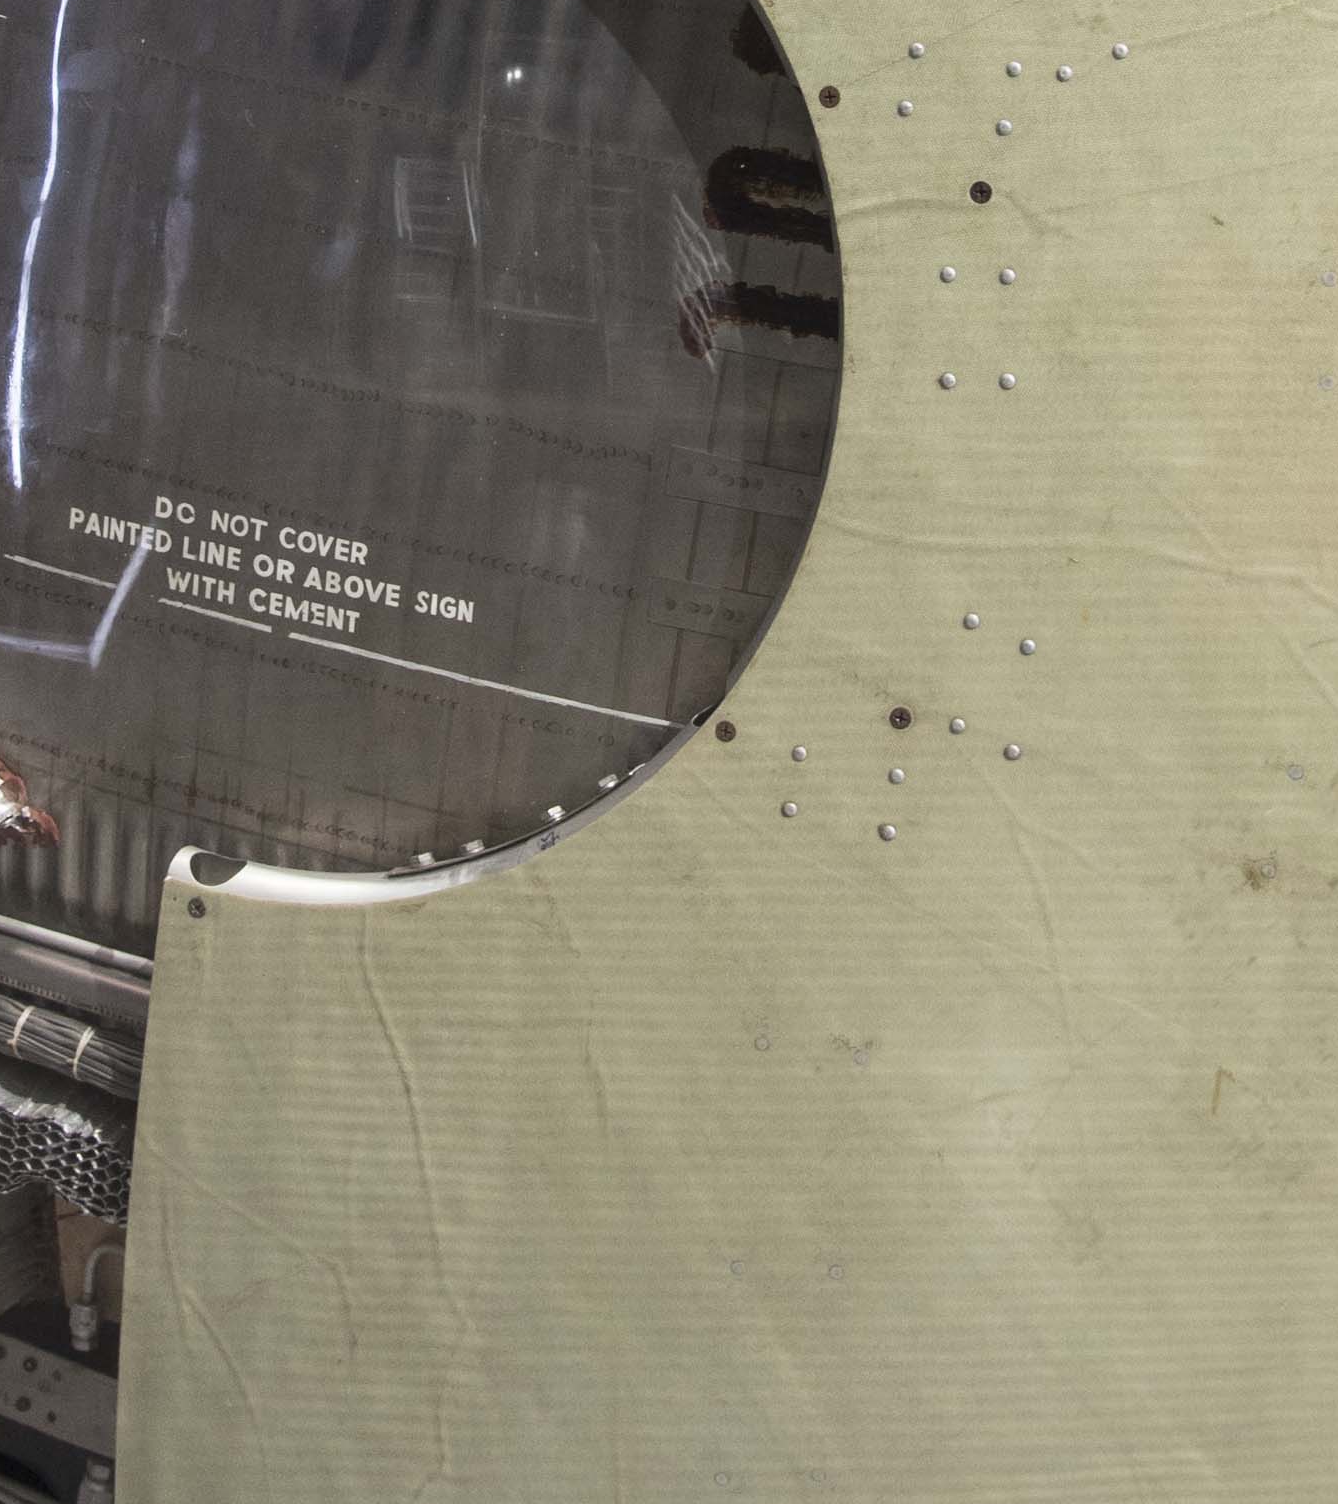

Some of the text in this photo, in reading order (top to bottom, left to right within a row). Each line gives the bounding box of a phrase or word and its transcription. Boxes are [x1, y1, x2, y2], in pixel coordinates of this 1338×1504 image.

[68, 507, 475, 625] PAINTED LINE OR ABOVE SIGN
[211, 510, 269, 542] NOT
[278, 526, 369, 566] COVER
[166, 567, 361, 633] WITH CEMENT
